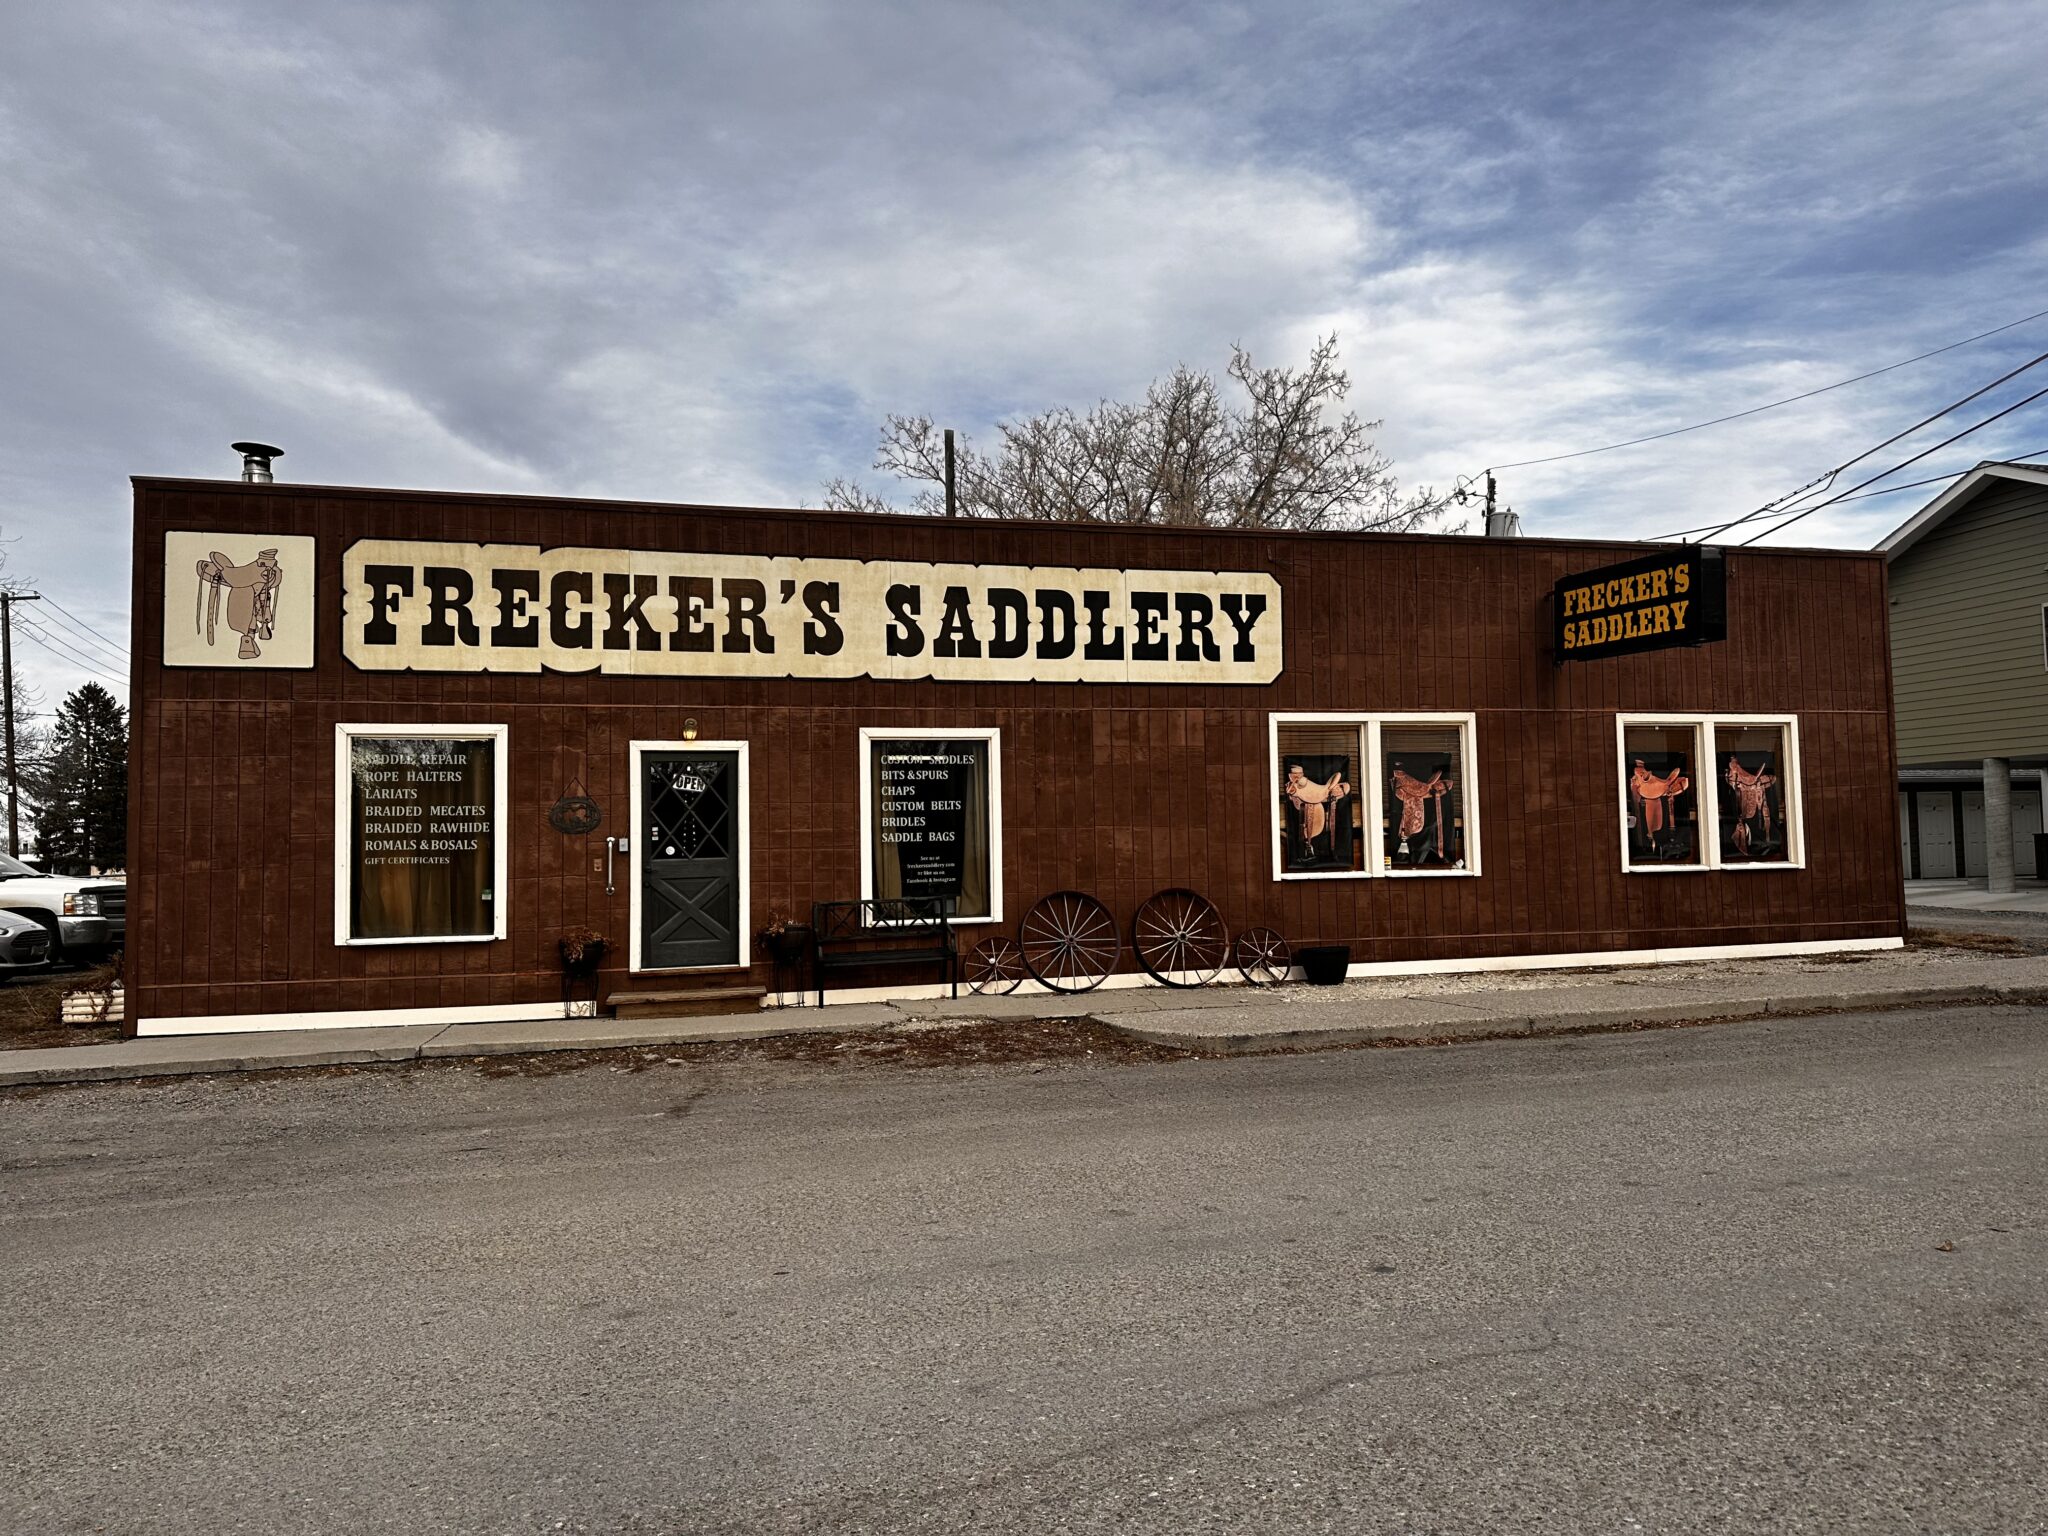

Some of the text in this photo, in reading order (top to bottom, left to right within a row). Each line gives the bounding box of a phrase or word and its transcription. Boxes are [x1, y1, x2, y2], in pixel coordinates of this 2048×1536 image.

[1563, 563, 1690, 617] FRECKER'S
[364, 564, 1267, 662] FRECKER'S SADDLERY
[1563, 600, 1690, 649] SADDLERY
[365, 754, 467, 765] SADDLE REPAIR
[881, 754, 975, 765] CUSTOM SADDLES
[365, 771, 462, 782] ROPE HALTERS
[881, 770, 949, 781] BITS & SPURS
[676, 775, 704, 790] OPEN
[365, 788, 418, 799] LARIATS
[881, 786, 915, 796] CHAPS
[365, 805, 486, 817] BRAIDED MECATES
[881, 800, 961, 812] CUSTOM BELTS
[882, 817, 926, 827] BRIDLES
[365, 822, 490, 834] BRAIDED RAWHIDE
[881, 831, 955, 843] SADDLE BAGS
[365, 840, 478, 851] ROMALS & BOSALS
[365, 856, 450, 865] GIFT CERTIFICATES
